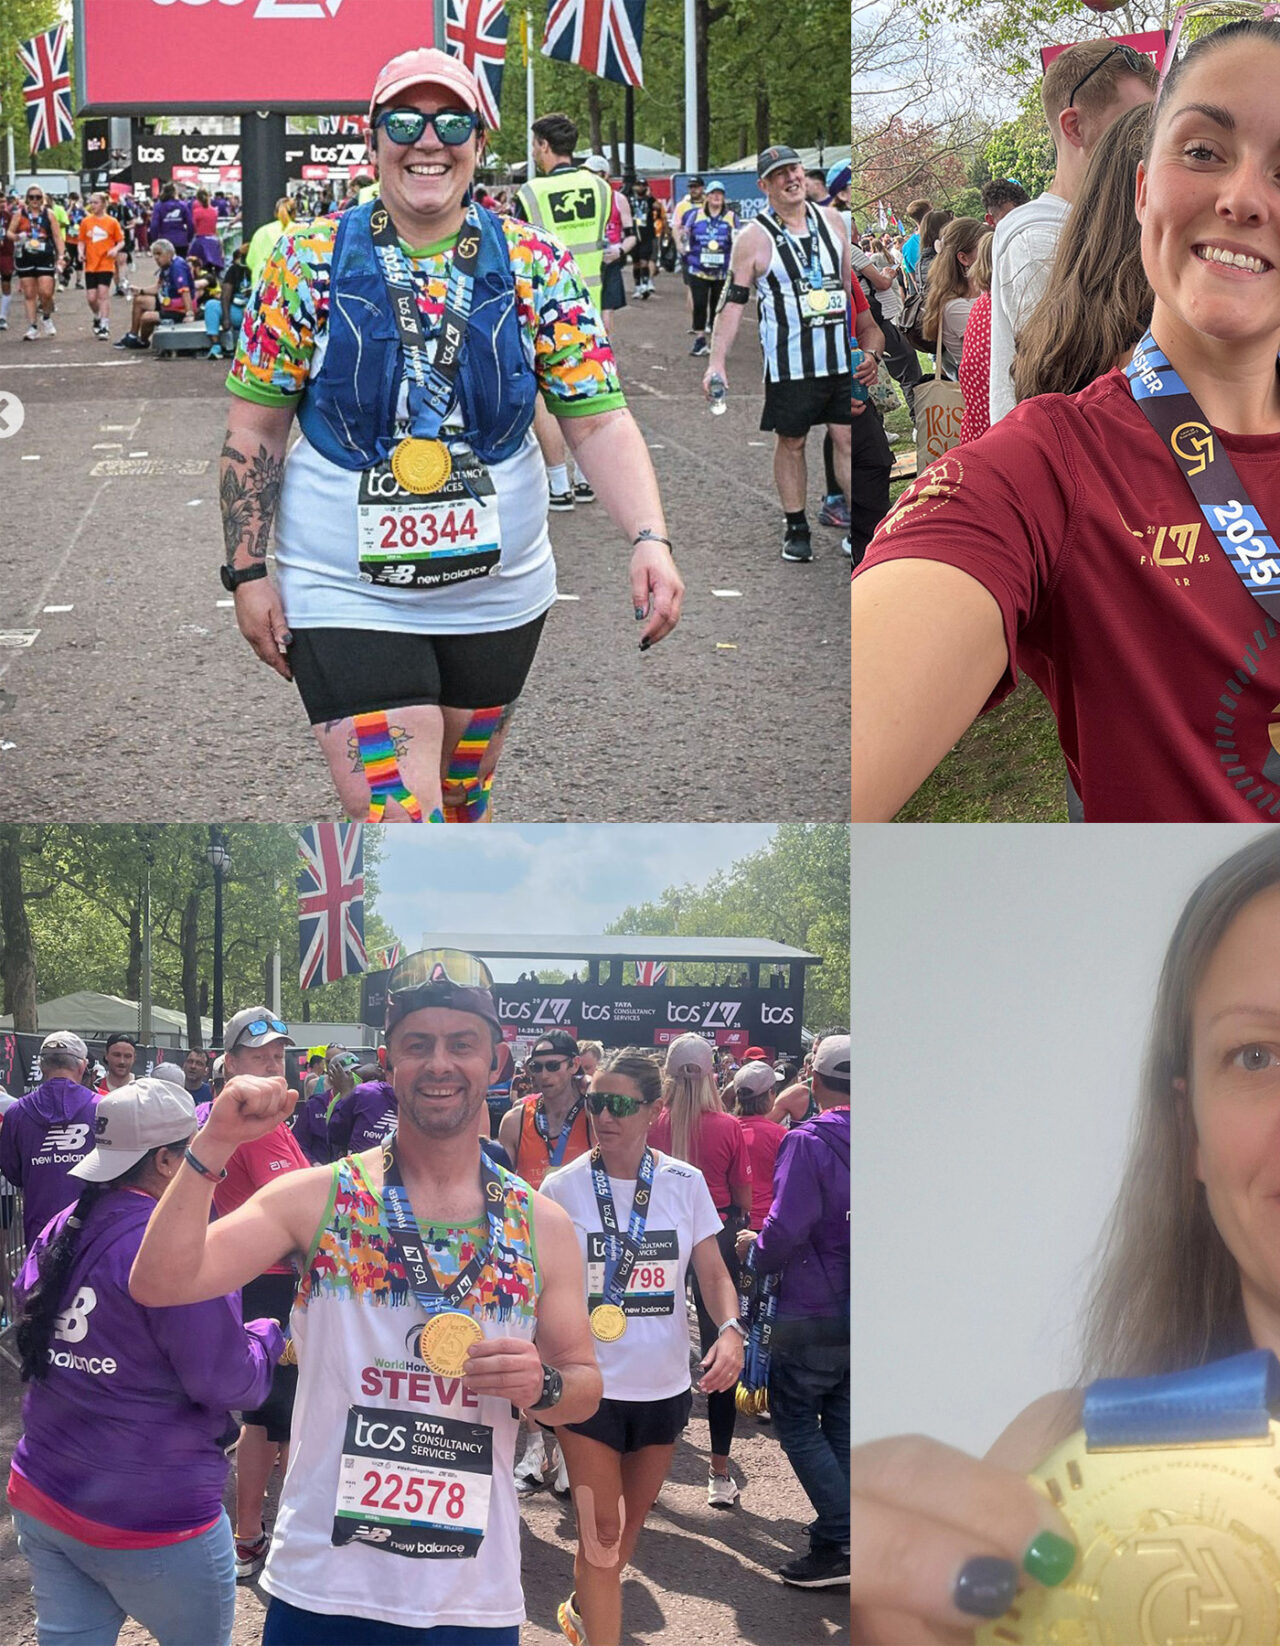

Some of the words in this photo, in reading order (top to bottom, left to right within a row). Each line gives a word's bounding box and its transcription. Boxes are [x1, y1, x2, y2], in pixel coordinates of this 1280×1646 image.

[138, 145, 165, 162] tcs
[182, 145, 209, 162] tcs
[310, 144, 337, 162] tcs
[381, 245, 404, 282] 2025
[379, 508, 478, 549] 28344
[1198, 553, 1211, 563] 25
[417, 574, 440, 584] new
[443, 566, 487, 580] balance
[498, 997, 531, 1019] tcs
[582, 1001, 611, 1020] tcs
[613, 1008, 656, 1016] CONSULTANCY
[667, 1001, 701, 1022] tcs
[761, 1002, 794, 1024] tcs
[363, 1130, 383, 1140] new
[31, 1155, 52, 1166] new
[54, 1153, 88, 1163] balan
[641, 1154, 653, 1180] 2025
[593, 1169, 608, 1196] 2025
[667, 1168, 692, 1178] 2XU
[388, 1188, 408, 1229] FINISHER
[412, 1264, 428, 1285] tcs
[630, 1267, 666, 1288] 798
[374, 1357, 433, 1373] WorldHors
[361, 1366, 479, 1408] STEVE
[355, 1414, 407, 1452] tcs
[415, 1421, 445, 1435] TATA
[411, 1445, 457, 1461] SERVICES
[413, 1433, 483, 1454] CONSULTANCY
[360, 1470, 466, 1519] 22578
[391, 1541, 415, 1552] new
[417, 1542, 465, 1553] balance
